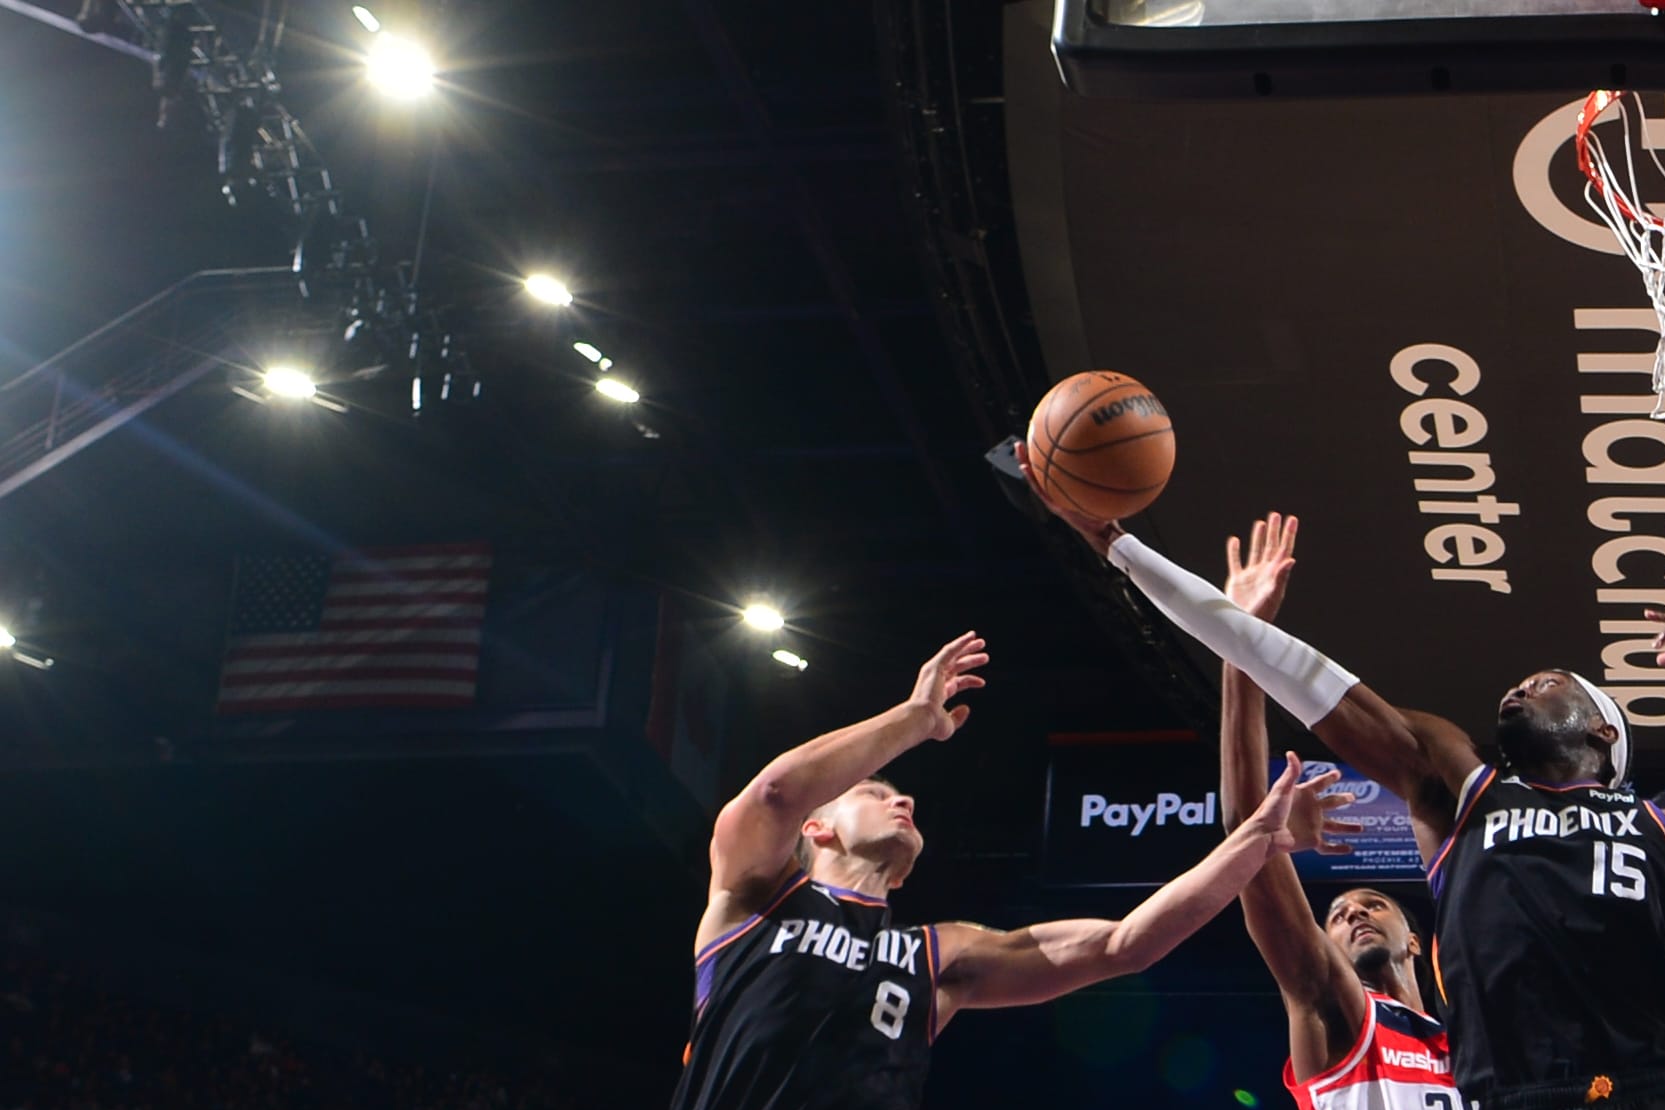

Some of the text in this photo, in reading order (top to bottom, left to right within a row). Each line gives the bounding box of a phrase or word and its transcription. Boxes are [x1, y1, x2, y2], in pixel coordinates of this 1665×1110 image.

[1390, 343, 1520, 593] center
[1080, 792, 1216, 837] PayPal
[1589, 788, 1635, 803] PayPal
[1483, 805, 1643, 850] PHOENIX
[1591, 841, 1647, 901] 15
[769, 919, 922, 975] PHOENIX
[870, 979, 911, 1040] 8
